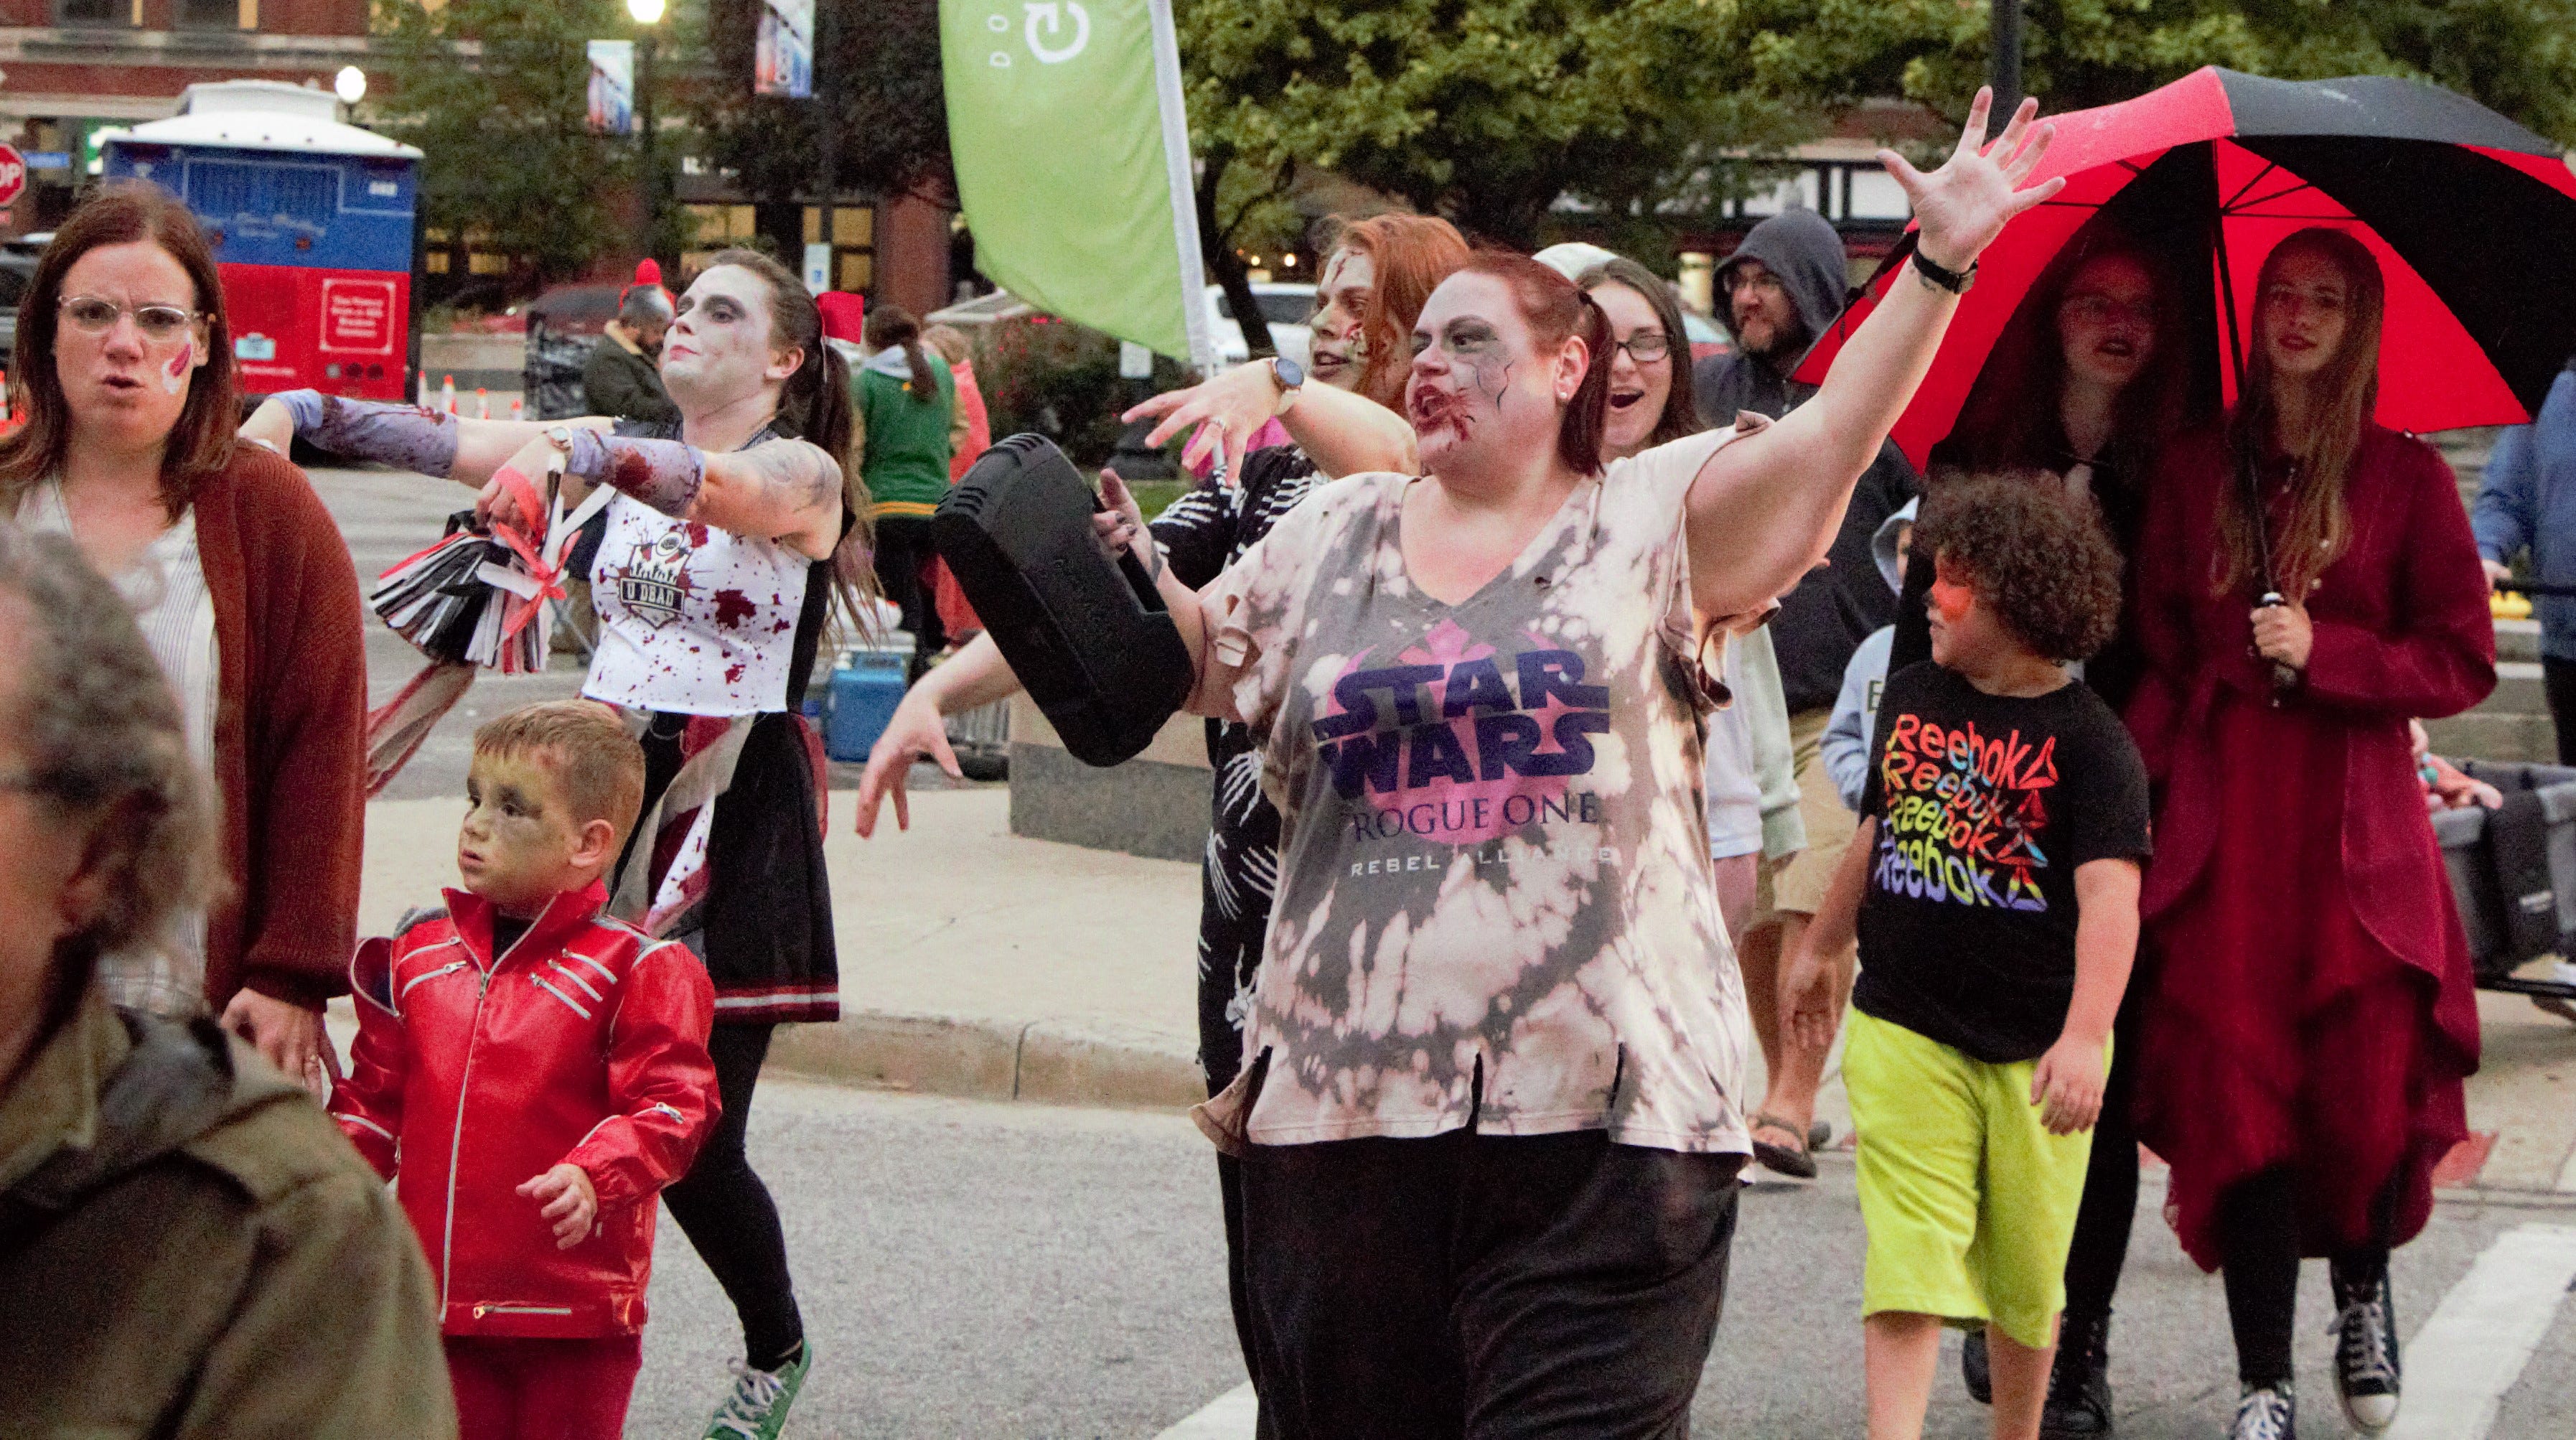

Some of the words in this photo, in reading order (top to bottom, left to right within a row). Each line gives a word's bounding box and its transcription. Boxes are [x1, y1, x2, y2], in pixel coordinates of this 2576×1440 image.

[627, 582, 636, 599] U
[640, 584, 674, 607] DEAD
[1311, 650, 1610, 741] STAR
[1319, 712, 1610, 800] WARS
[1886, 714, 2033, 790] Reebok
[1353, 795, 1491, 843] ROGUE
[1502, 790, 1598, 826] ONE
[1882, 751, 2008, 827] Reebok
[1351, 856, 1440, 877] REBEL
[1458, 846, 1613, 866] ALLANE
[1883, 792, 2000, 861] Reebok
